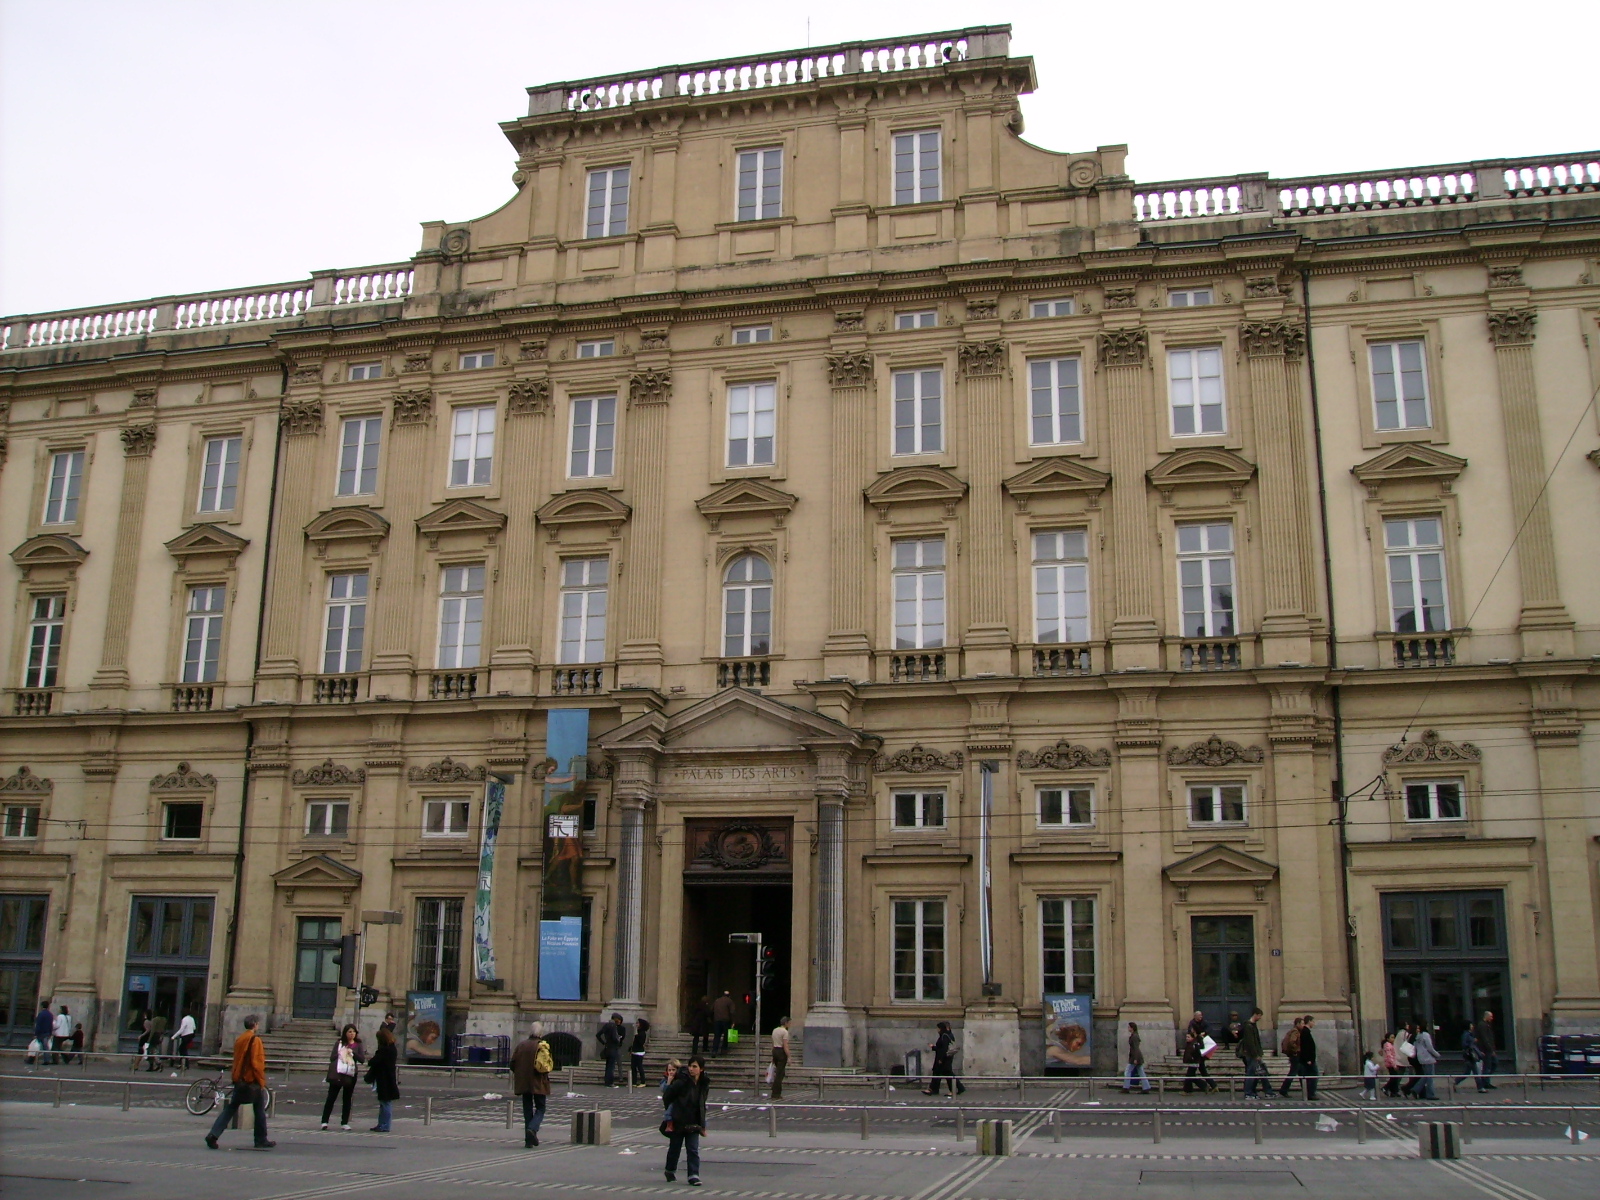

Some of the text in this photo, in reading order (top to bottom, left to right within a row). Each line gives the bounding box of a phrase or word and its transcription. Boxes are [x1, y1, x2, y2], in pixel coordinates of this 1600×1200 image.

[682, 767, 797, 780] PALAIS DES ARTS
